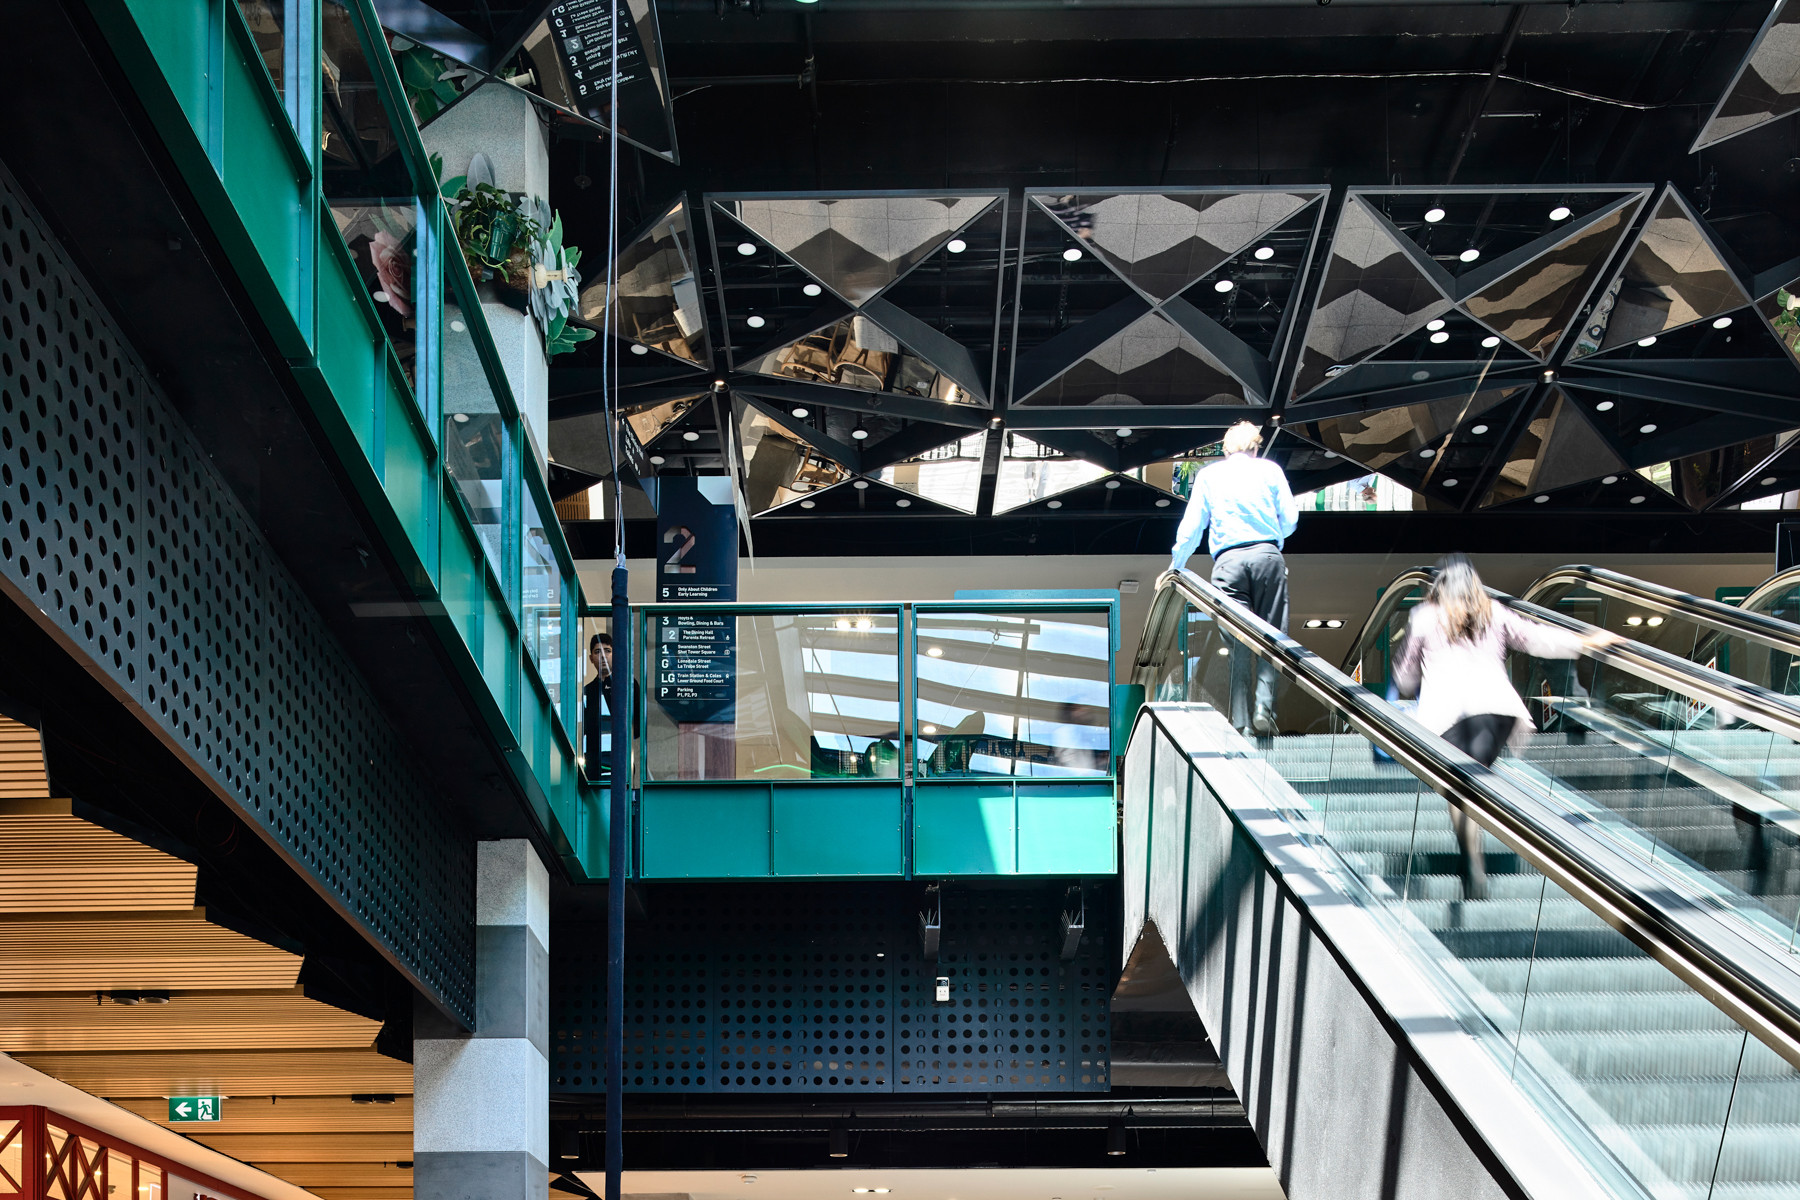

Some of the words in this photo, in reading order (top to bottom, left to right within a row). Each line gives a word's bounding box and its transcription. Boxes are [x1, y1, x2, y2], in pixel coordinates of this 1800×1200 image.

[664, 526, 696, 573] 2
[662, 587, 670, 598] 5
[662, 616, 670, 626] 3
[668, 630, 676, 640] 2
[662, 645, 669, 655] 1
[661, 659, 669, 669] G
[661, 673, 676, 683] LG
[661, 687, 669, 697] P
